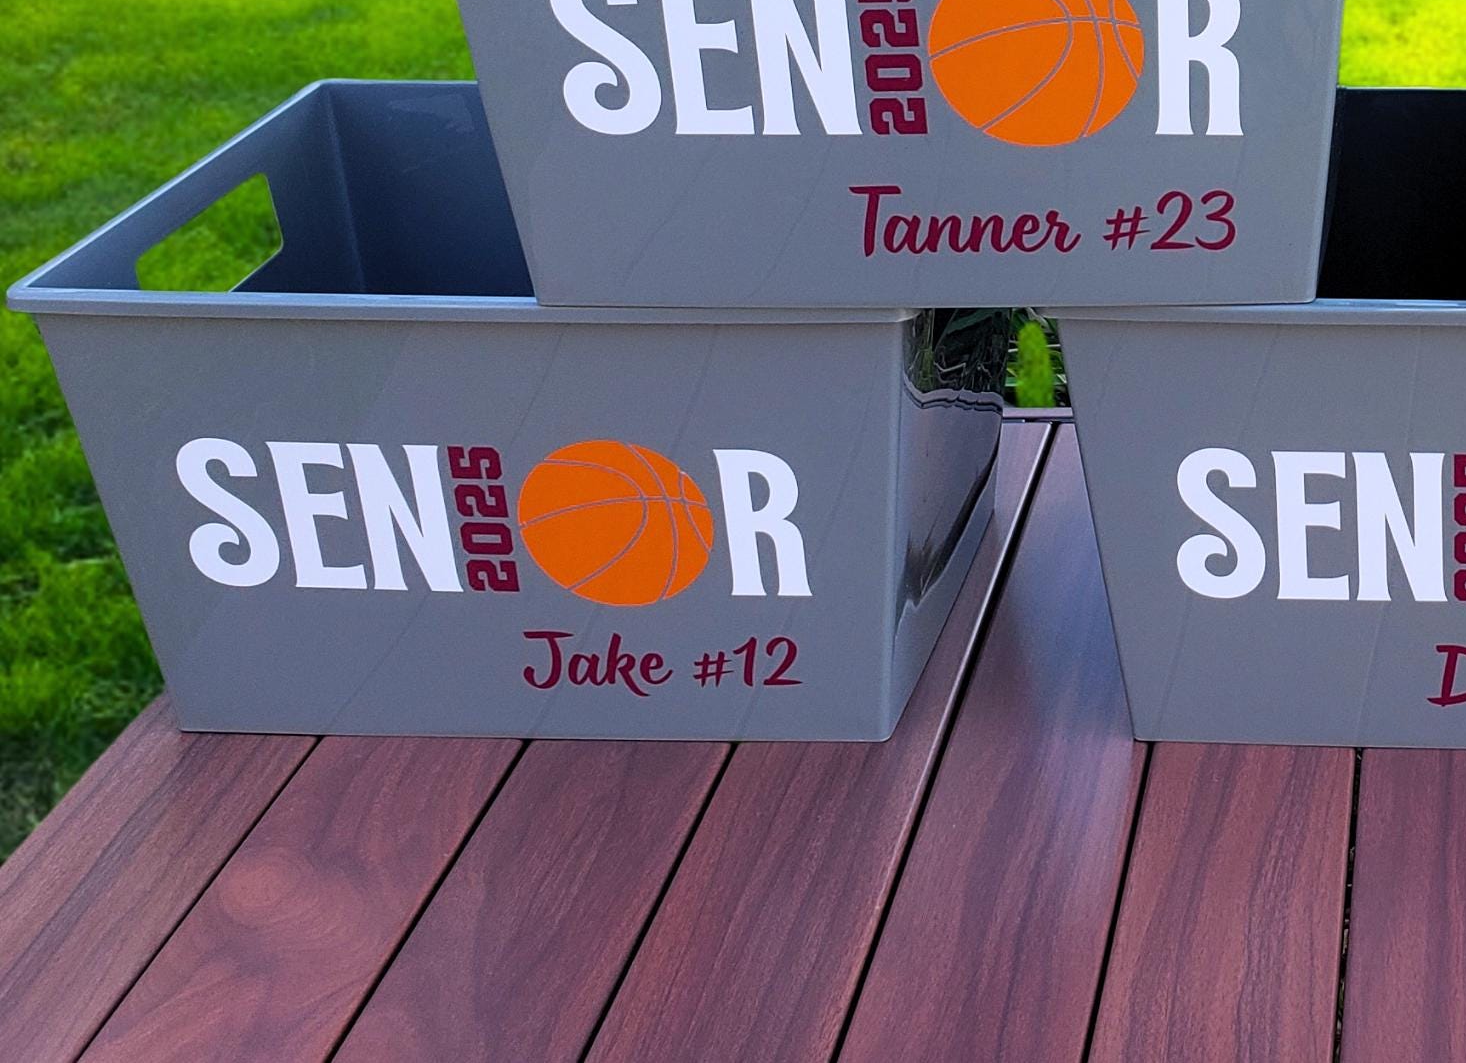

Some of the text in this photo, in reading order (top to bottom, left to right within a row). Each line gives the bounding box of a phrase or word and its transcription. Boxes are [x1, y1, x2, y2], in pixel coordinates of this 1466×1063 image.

[850, 185, 1236, 256] Tanner #23
[447, 445, 520, 593] 2025
[523, 630, 800, 697] Jake #12
